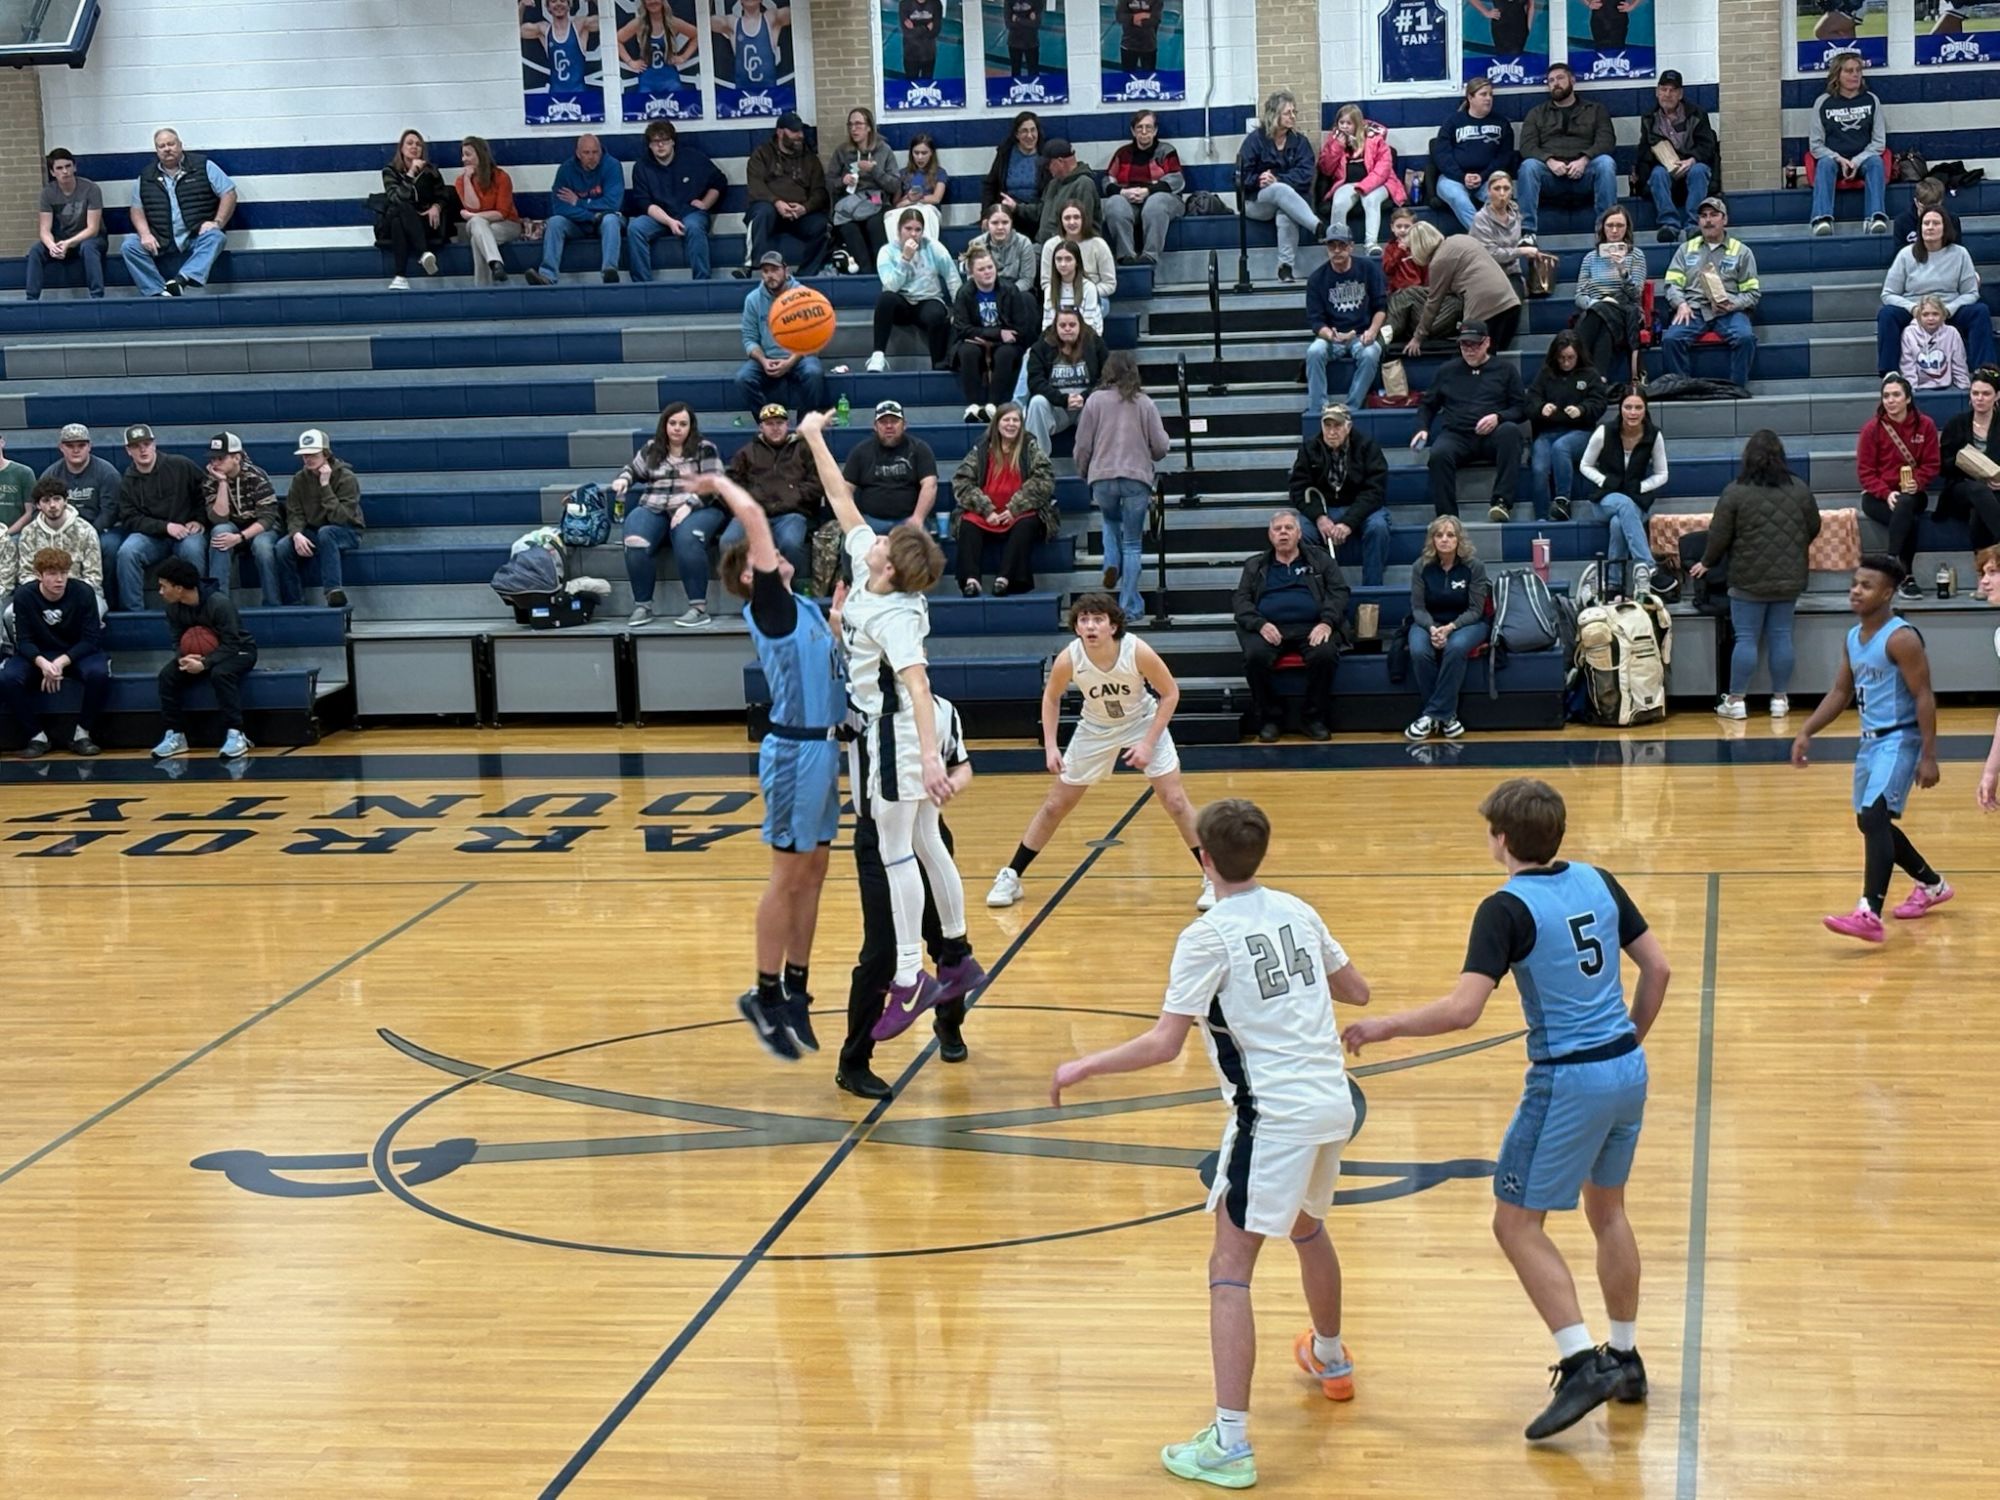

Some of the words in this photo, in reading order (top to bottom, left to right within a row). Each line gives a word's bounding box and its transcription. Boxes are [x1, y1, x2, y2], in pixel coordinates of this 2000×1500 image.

[1395, 7, 1433, 33] #1
[1402, 33, 1428, 46] FAN
[781, 305, 826, 325] Wilson
[1089, 683, 1131, 699] CAVS
[3, 791, 856, 822] OUNTY
[3, 823, 856, 858] ARROL
[1566, 910, 1605, 979] 5
[1245, 924, 1316, 1000] 24
